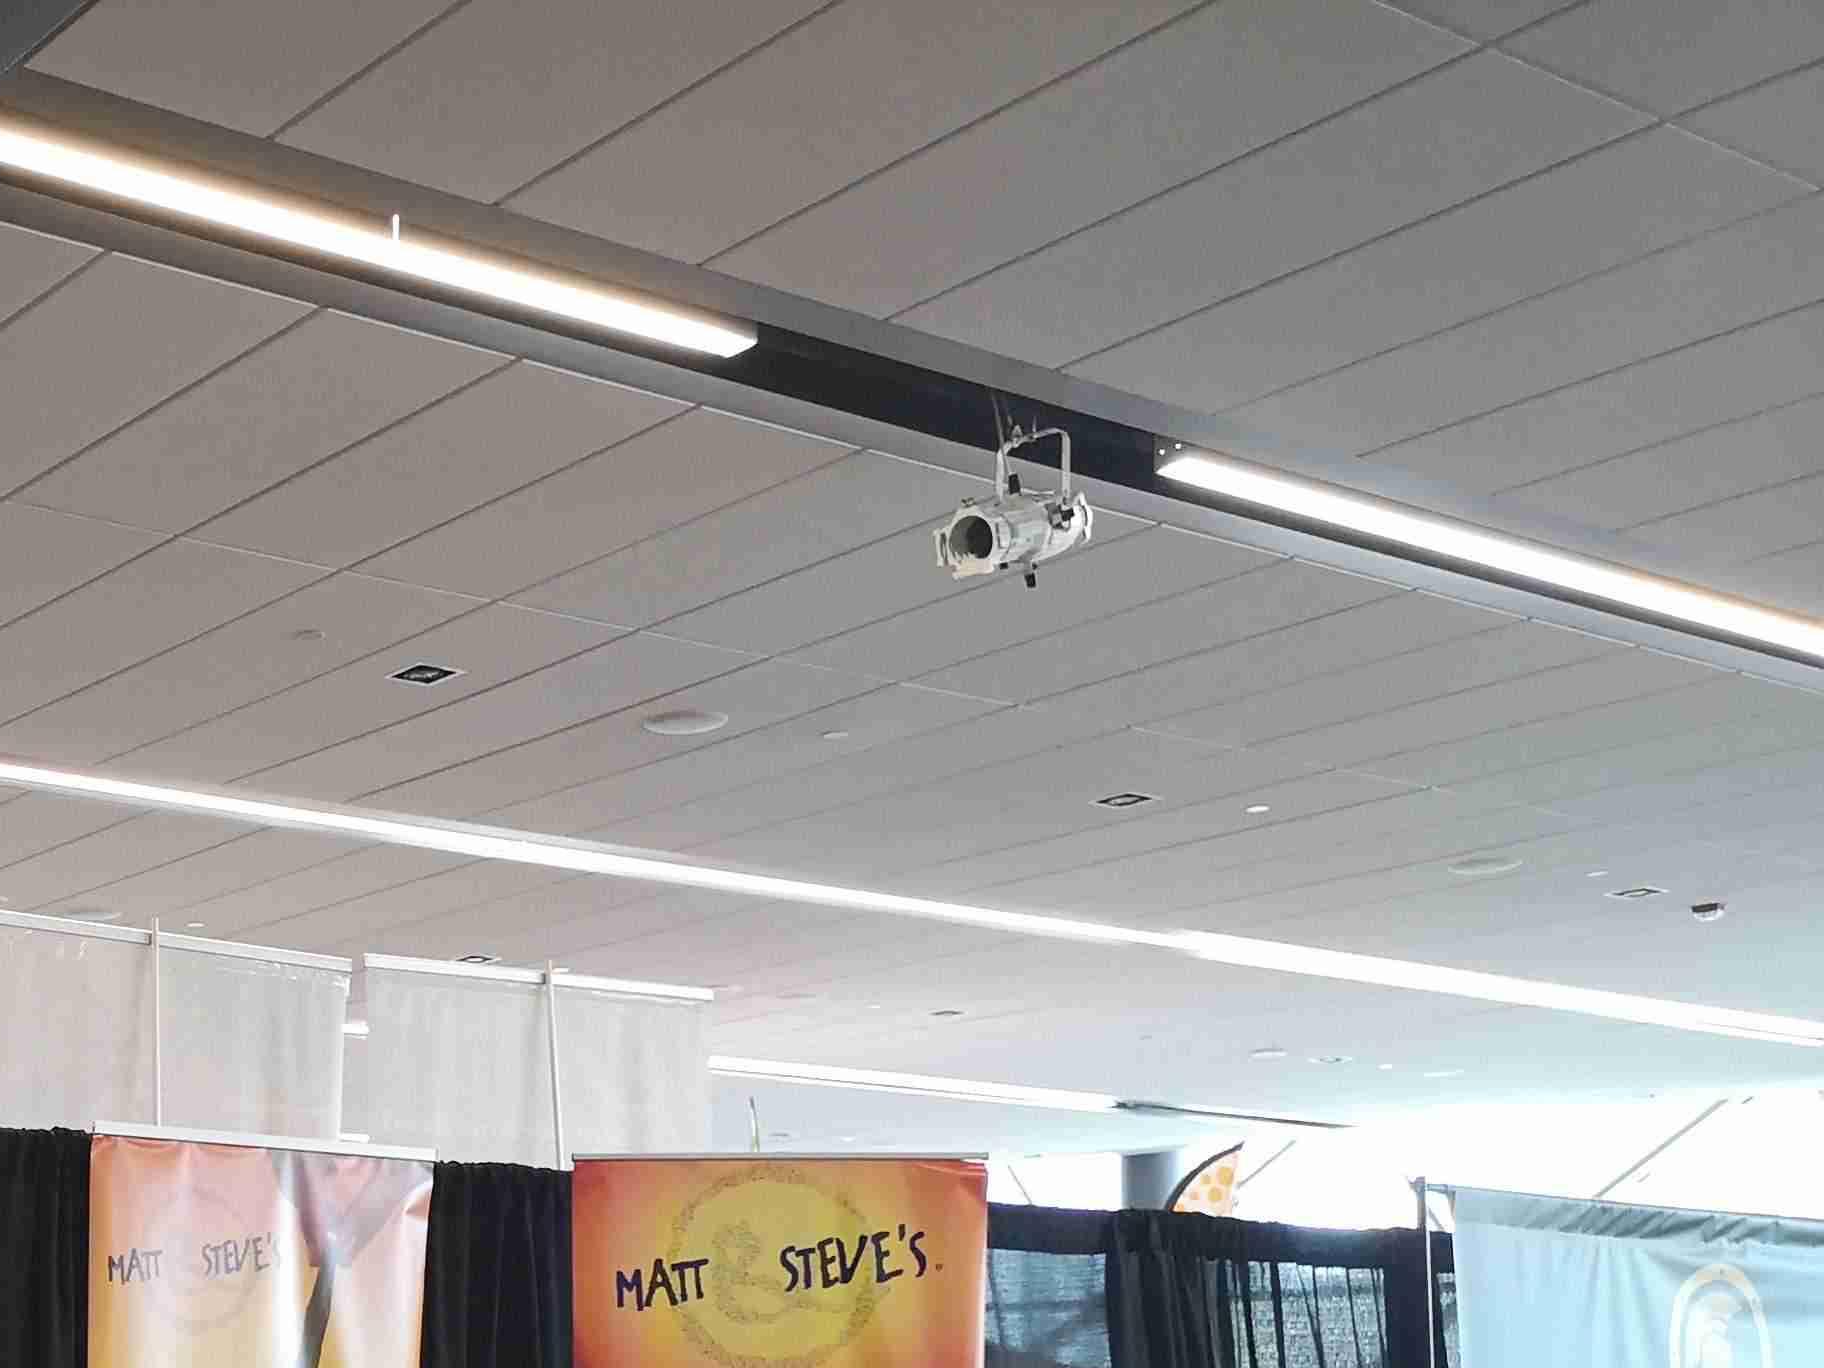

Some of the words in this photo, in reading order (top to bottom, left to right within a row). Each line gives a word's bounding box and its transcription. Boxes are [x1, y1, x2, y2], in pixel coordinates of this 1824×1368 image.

[107, 1247, 164, 1285] MATT
[616, 1258, 709, 1311] MATT
[779, 1224, 928, 1292] STEVE'S
